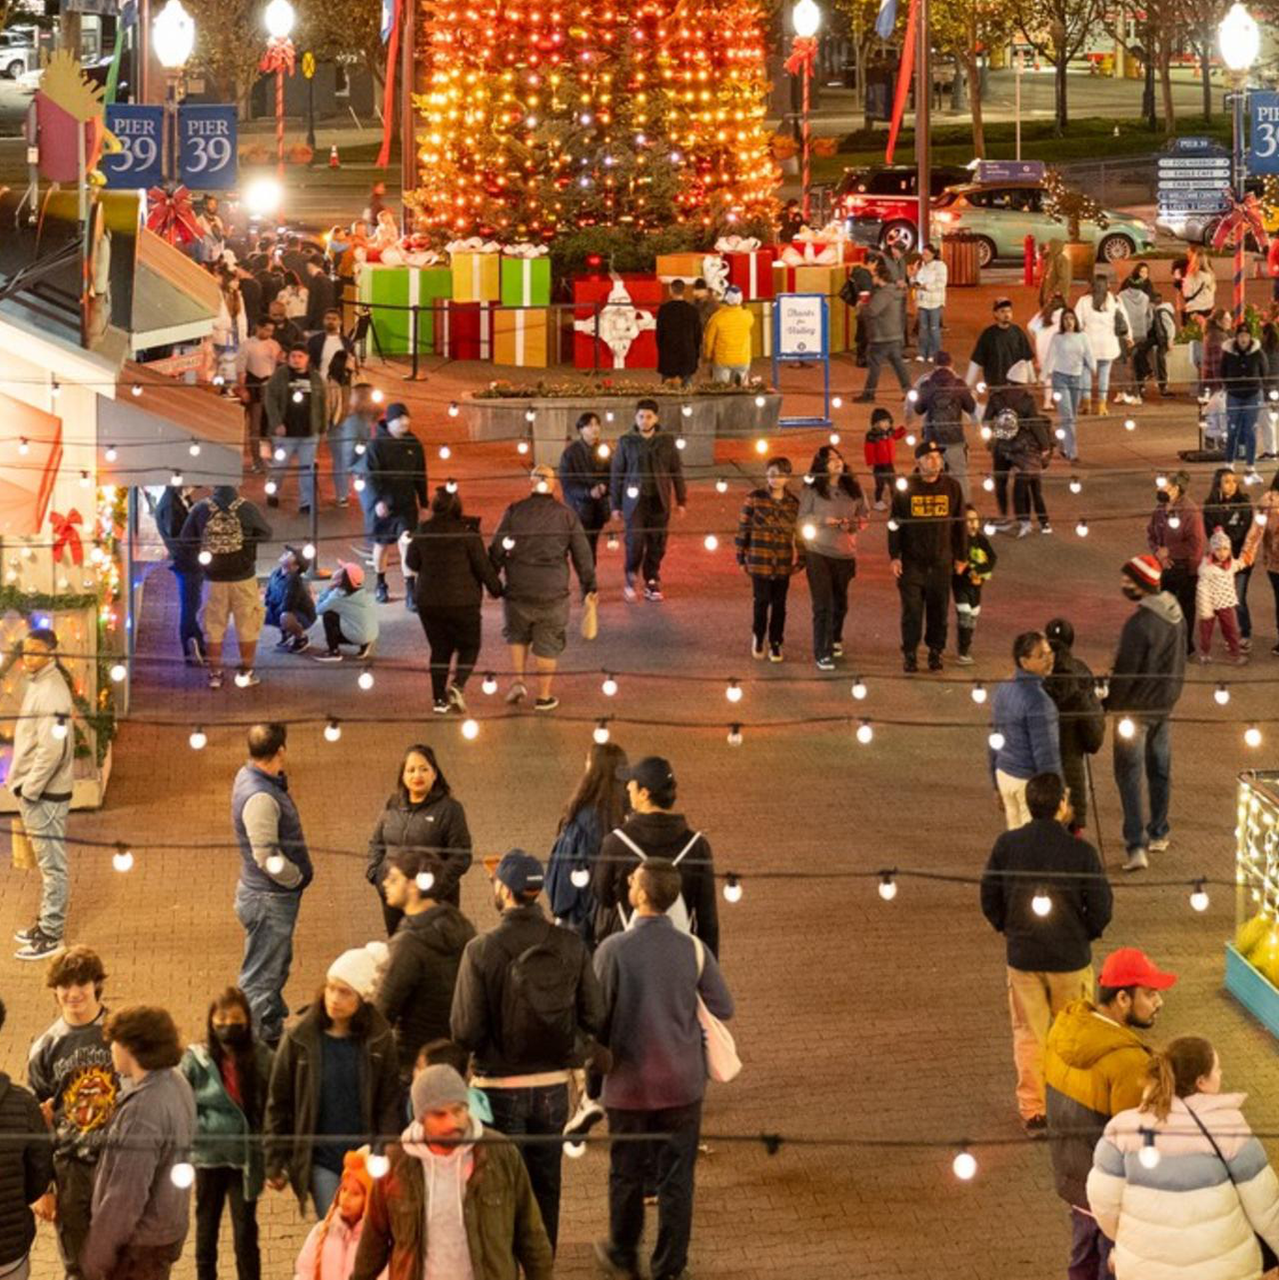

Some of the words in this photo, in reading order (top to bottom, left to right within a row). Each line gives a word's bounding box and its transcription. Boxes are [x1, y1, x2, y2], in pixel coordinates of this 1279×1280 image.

[113, 118, 156, 135] PIER
[186, 119, 230, 136] PIER
[111, 135, 157, 172] 39
[186, 136, 231, 173] 39
